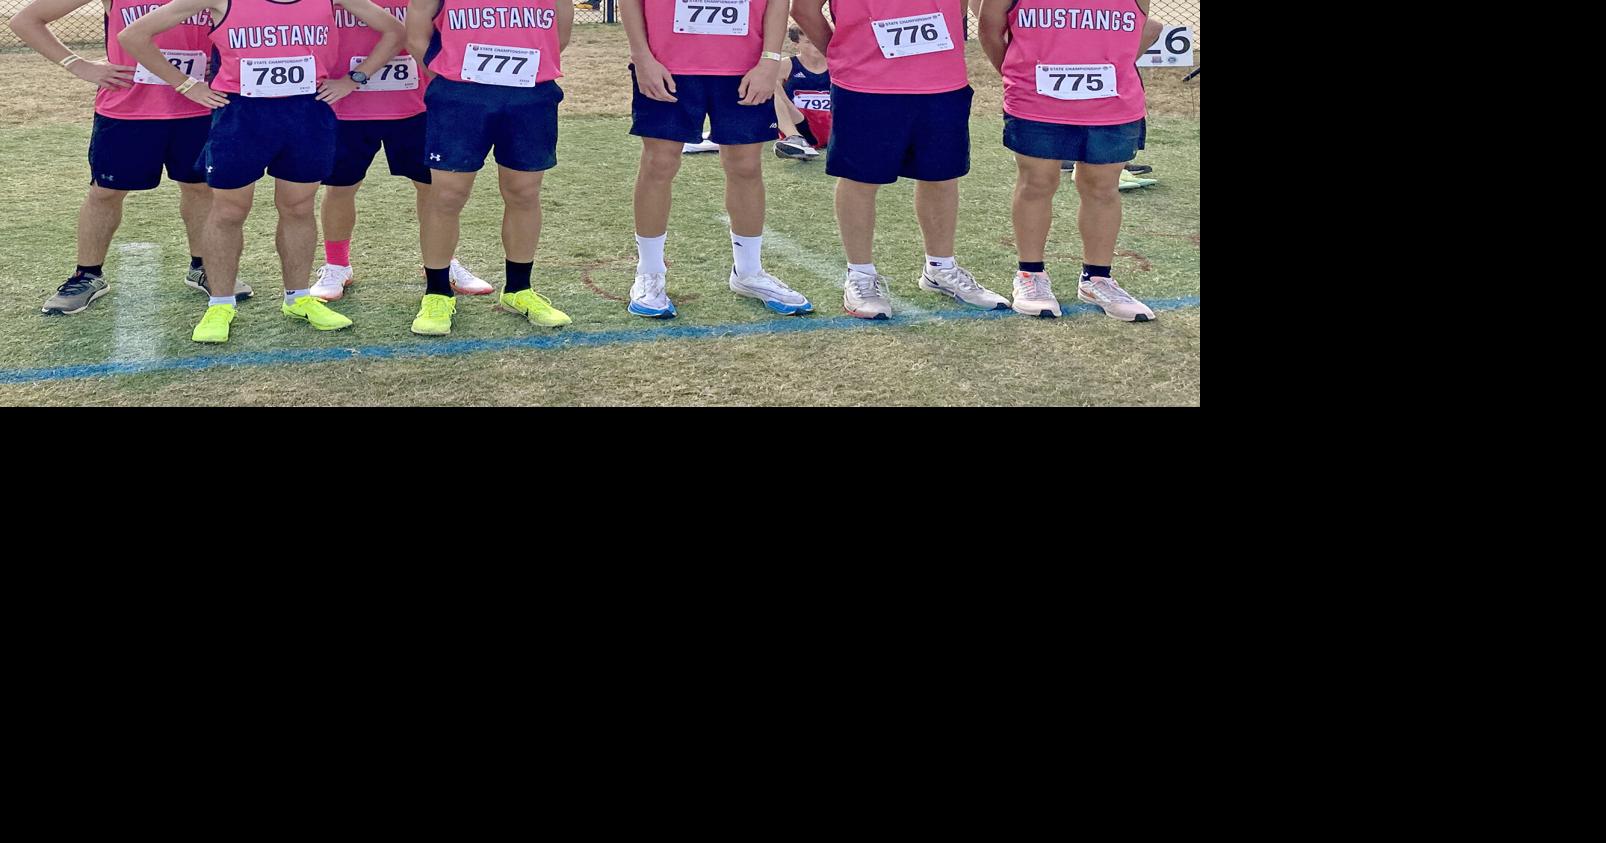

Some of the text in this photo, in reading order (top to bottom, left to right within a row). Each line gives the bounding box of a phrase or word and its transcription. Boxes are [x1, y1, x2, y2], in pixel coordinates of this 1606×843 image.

[448, 6, 555, 30] MUSTANGS
[687, 5, 739, 25] 779
[1017, 7, 1137, 32] MUSTANGS
[228, 24, 329, 49] MUSTANGS
[886, 23, 939, 46] 776
[380, 64, 409, 81] 78
[477, 53, 528, 75] 777
[252, 65, 305, 86] 780
[1049, 73, 1104, 92] 775
[801, 99, 831, 110] 792
